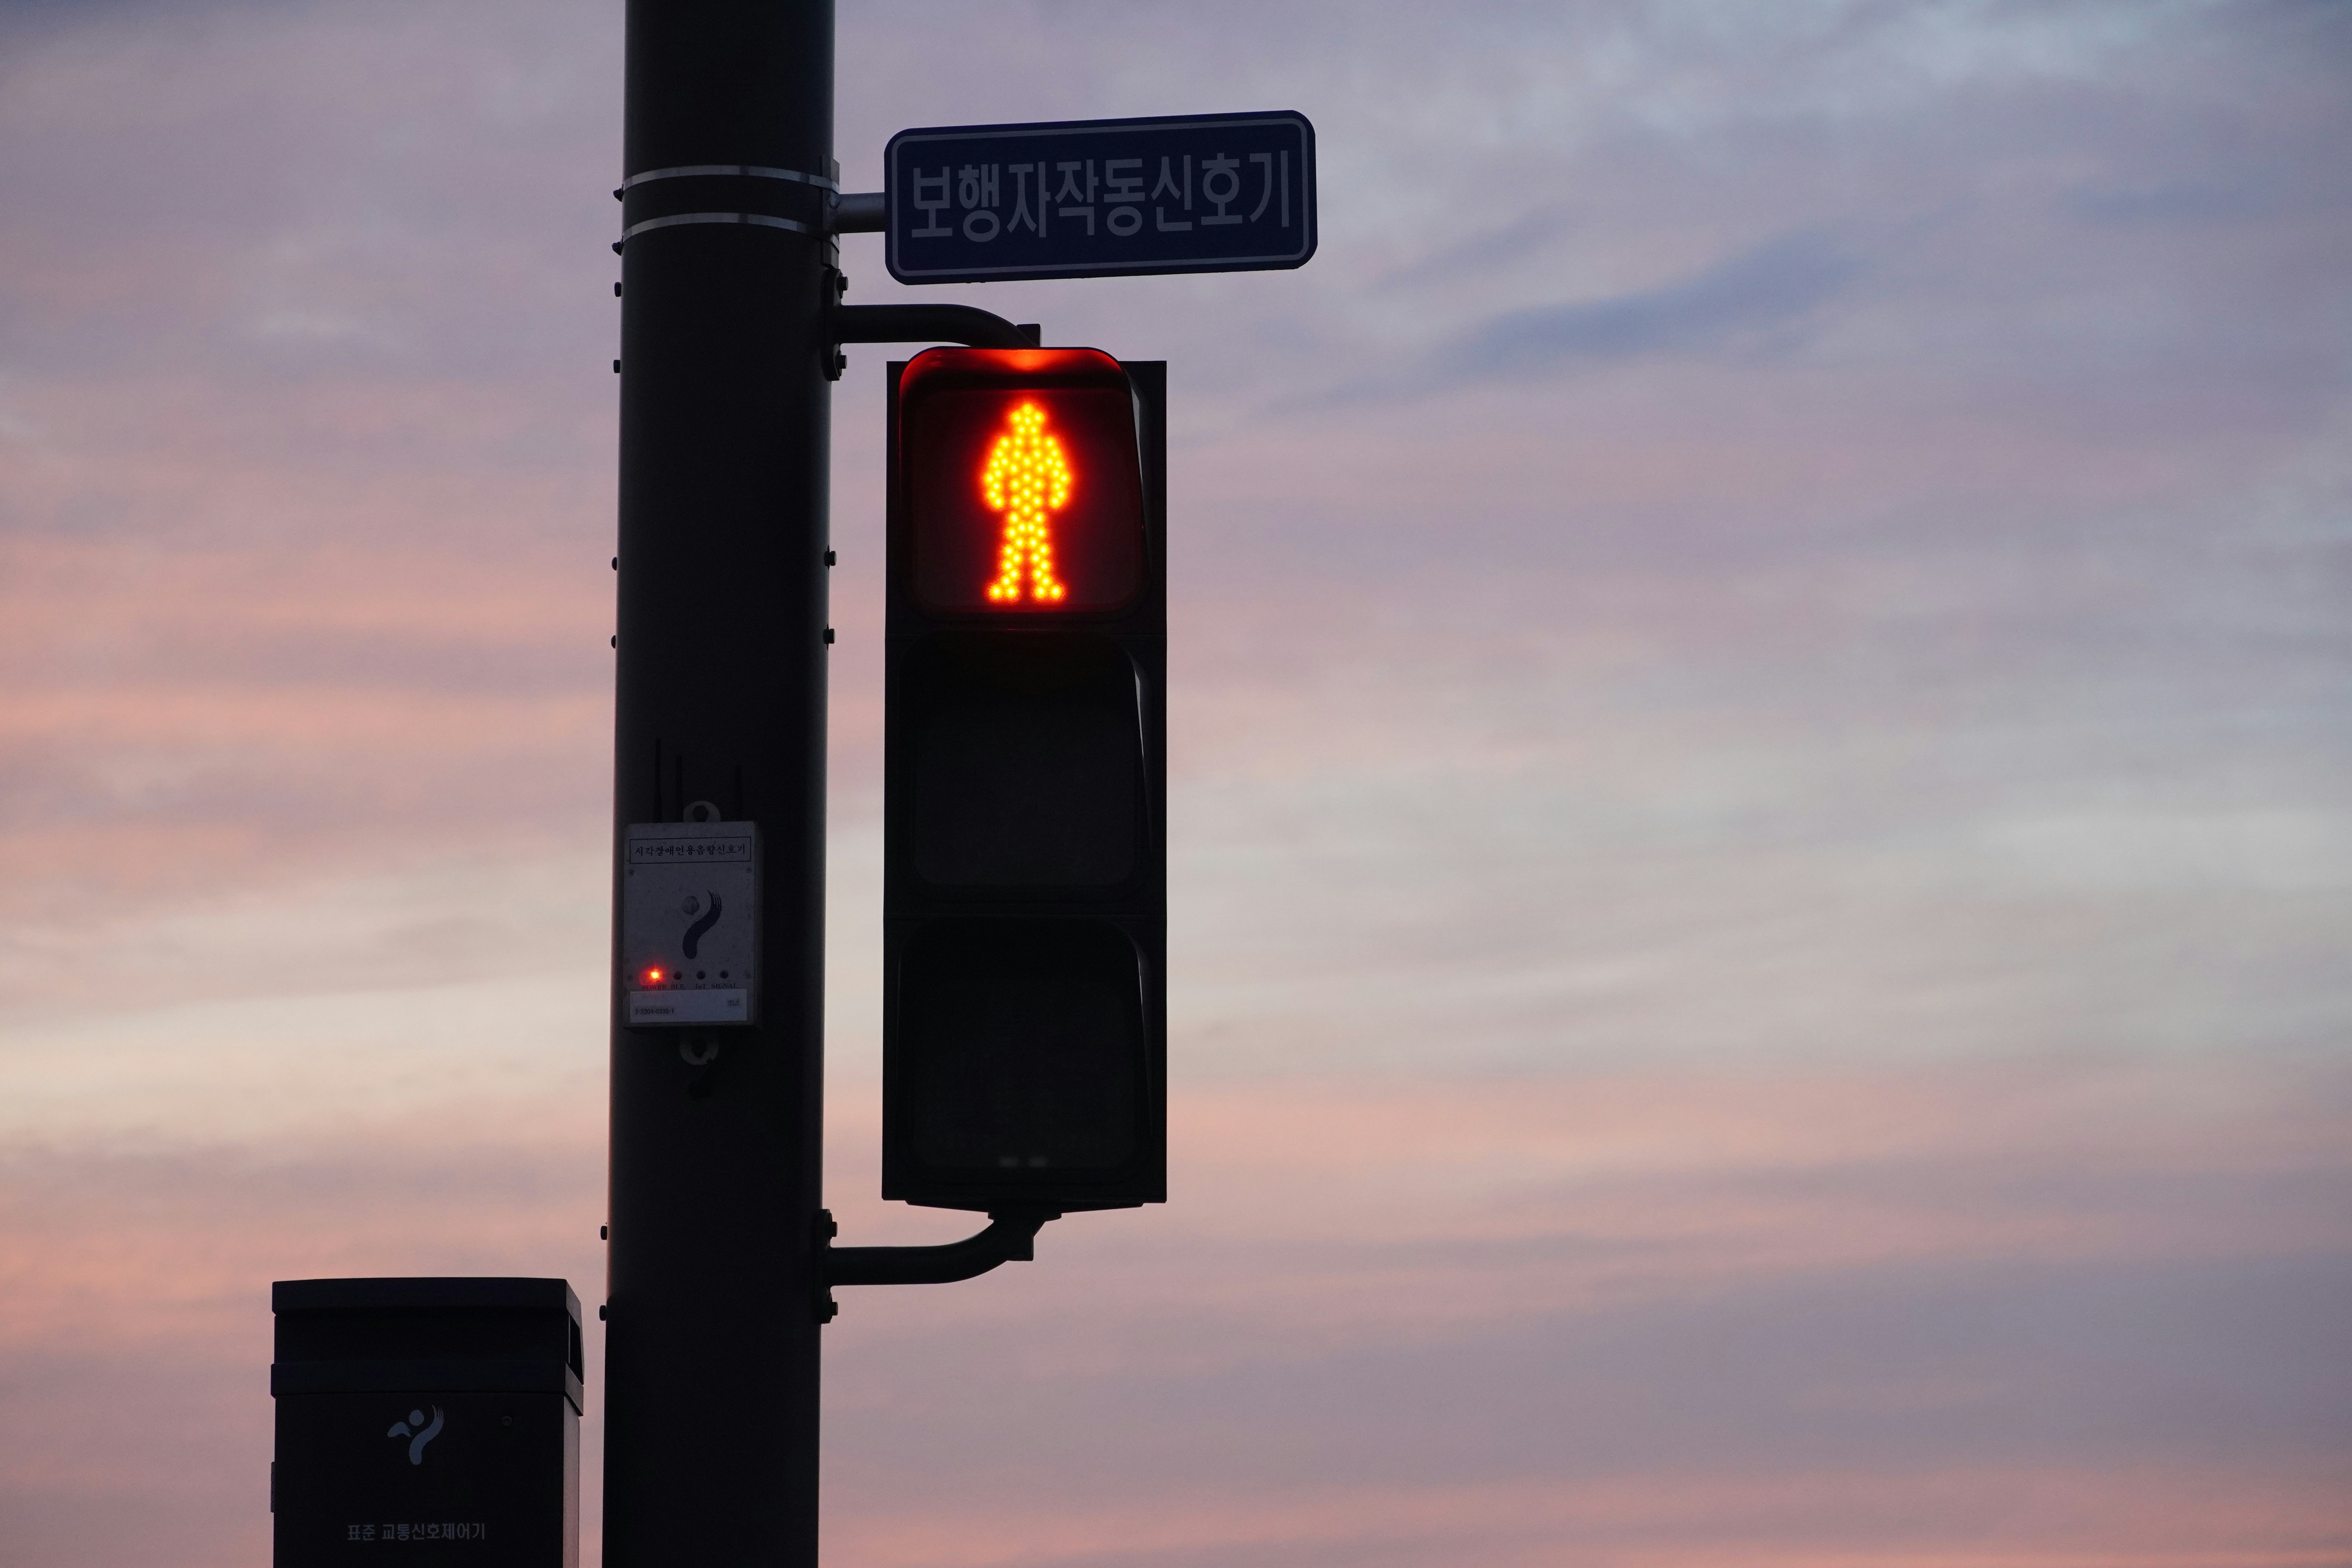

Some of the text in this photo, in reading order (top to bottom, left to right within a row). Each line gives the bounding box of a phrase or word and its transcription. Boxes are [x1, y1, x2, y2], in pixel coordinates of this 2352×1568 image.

[911, 150, 1290, 242] 보행자작동신호기
[633, 844, 745, 857] 시각장애인용음향신호기
[347, 1523, 486, 1541] 표준 교통신호제어기
